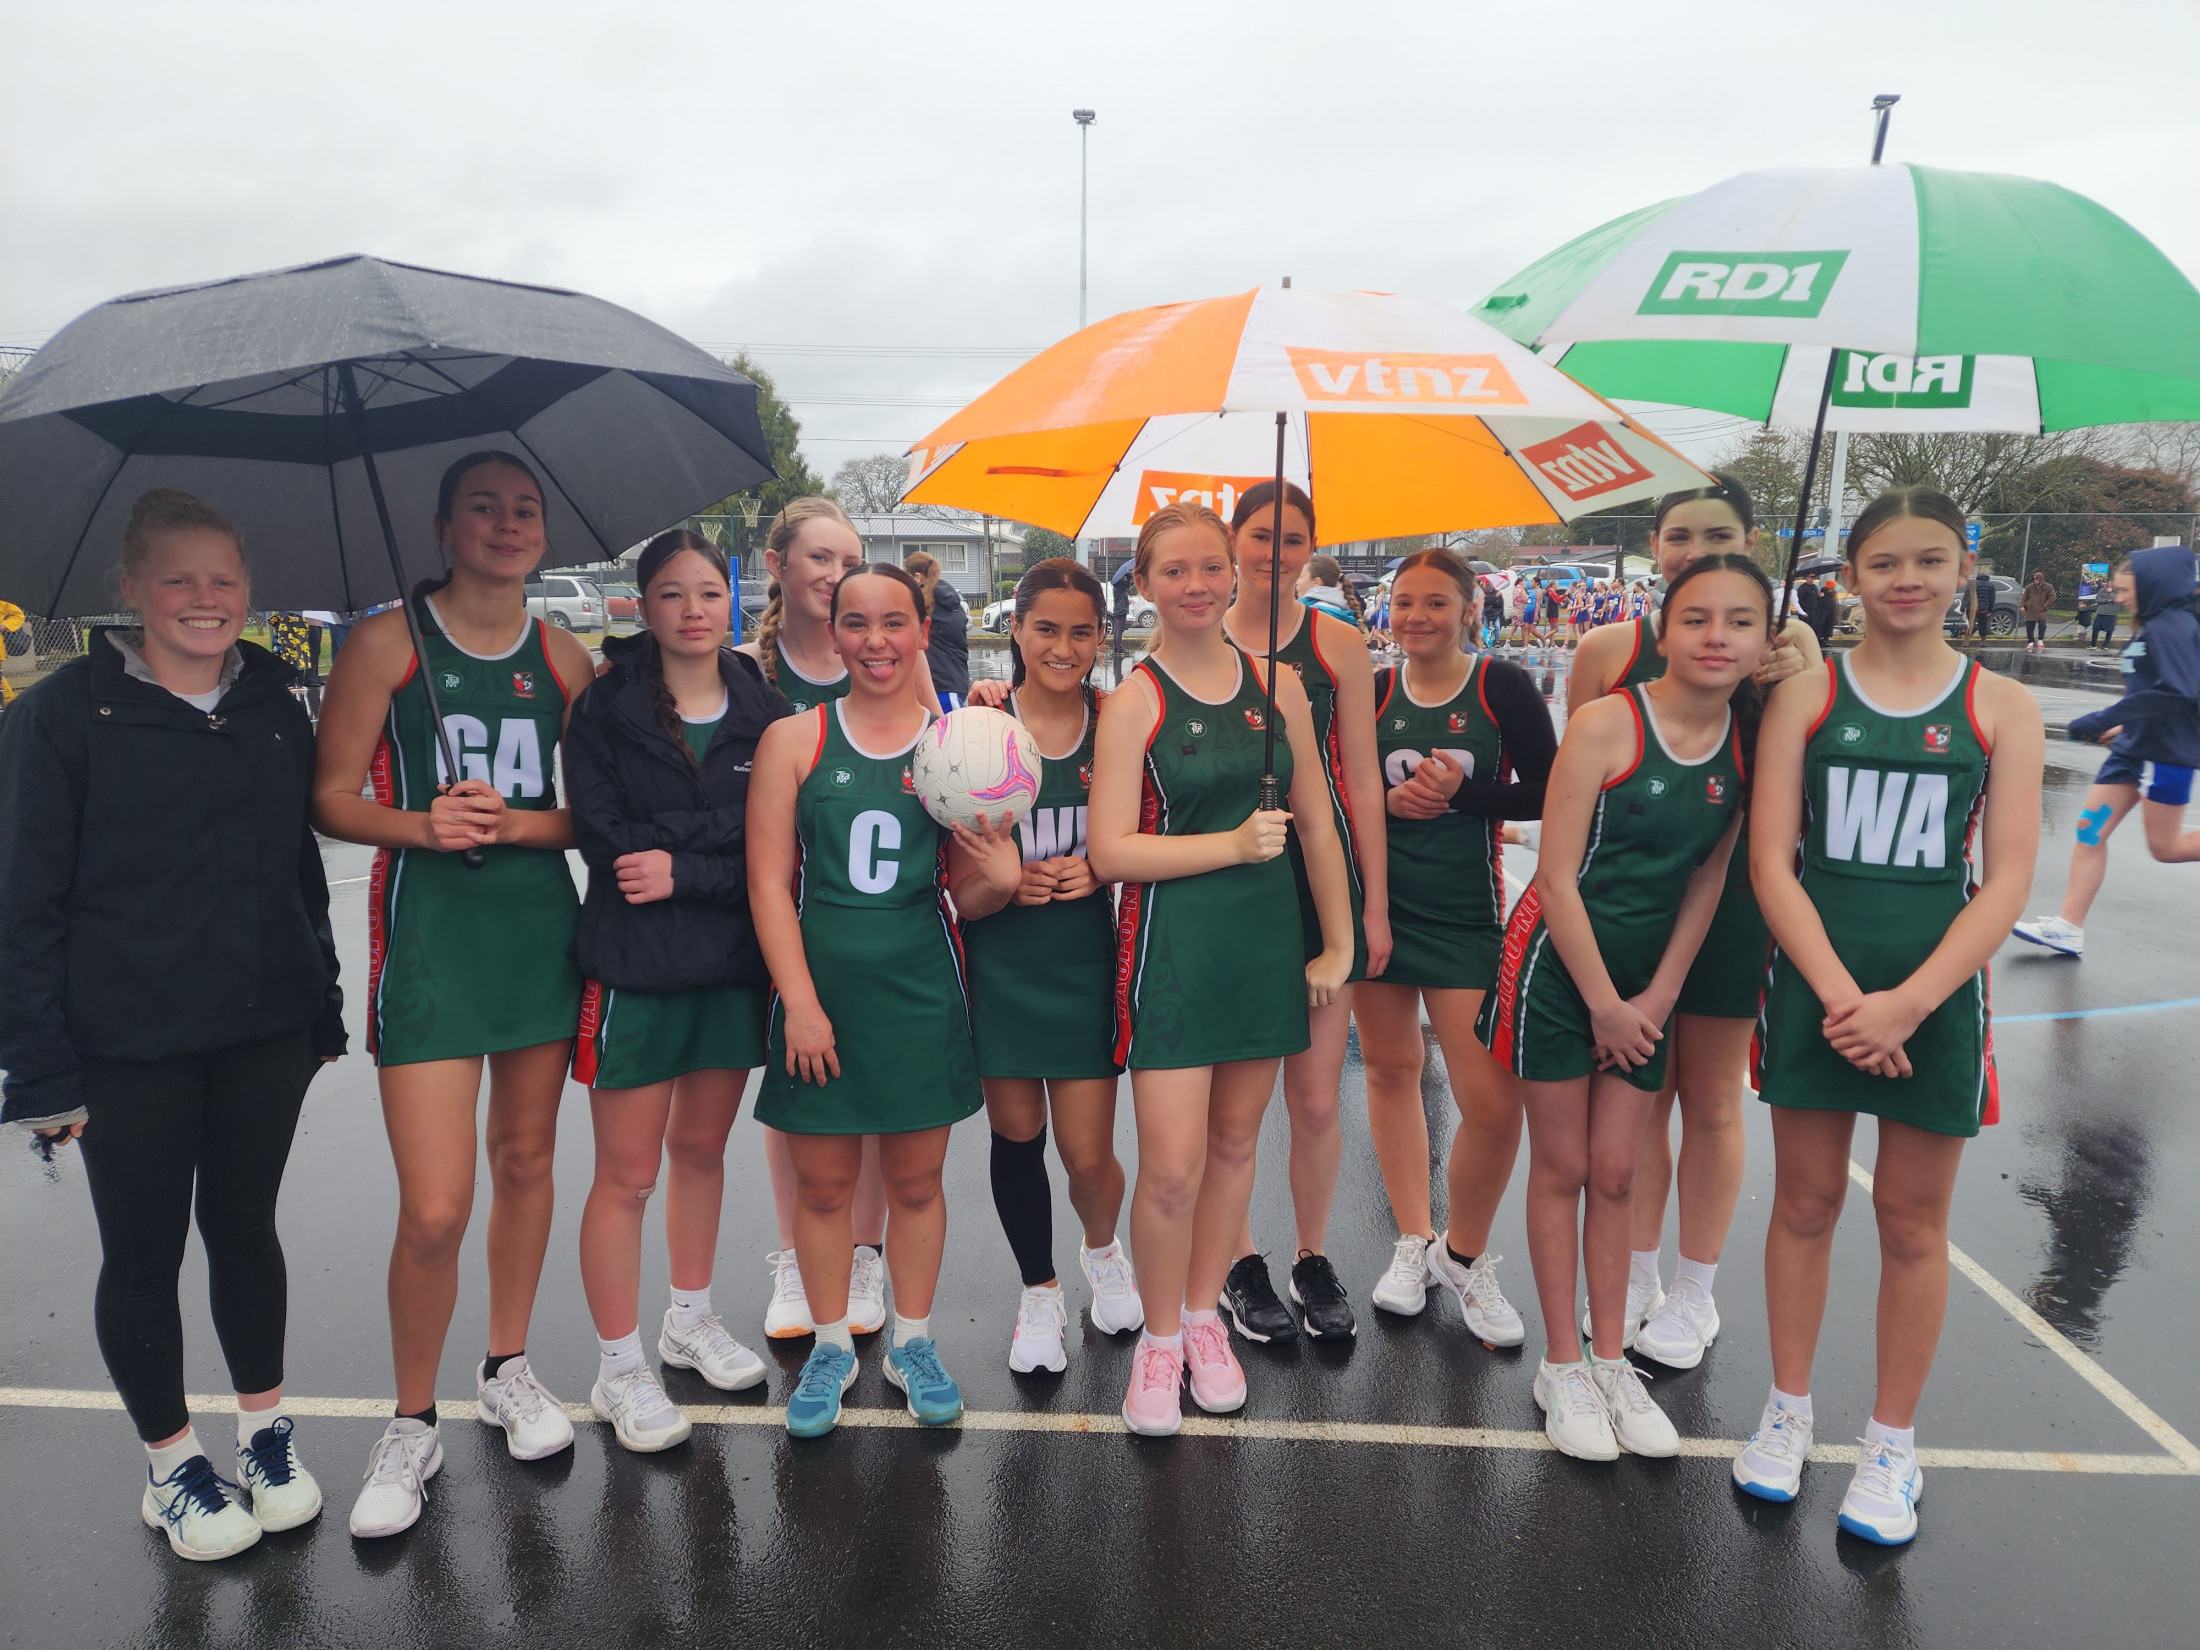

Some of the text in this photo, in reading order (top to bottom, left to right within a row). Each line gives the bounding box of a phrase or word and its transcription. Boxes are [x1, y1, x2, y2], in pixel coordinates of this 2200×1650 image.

[1659, 262, 1822, 301] RD1
[1308, 358, 1499, 397] vtnz
[435, 713, 543, 798] GA
[848, 810, 902, 895] C
[1825, 766, 1949, 868] WA
